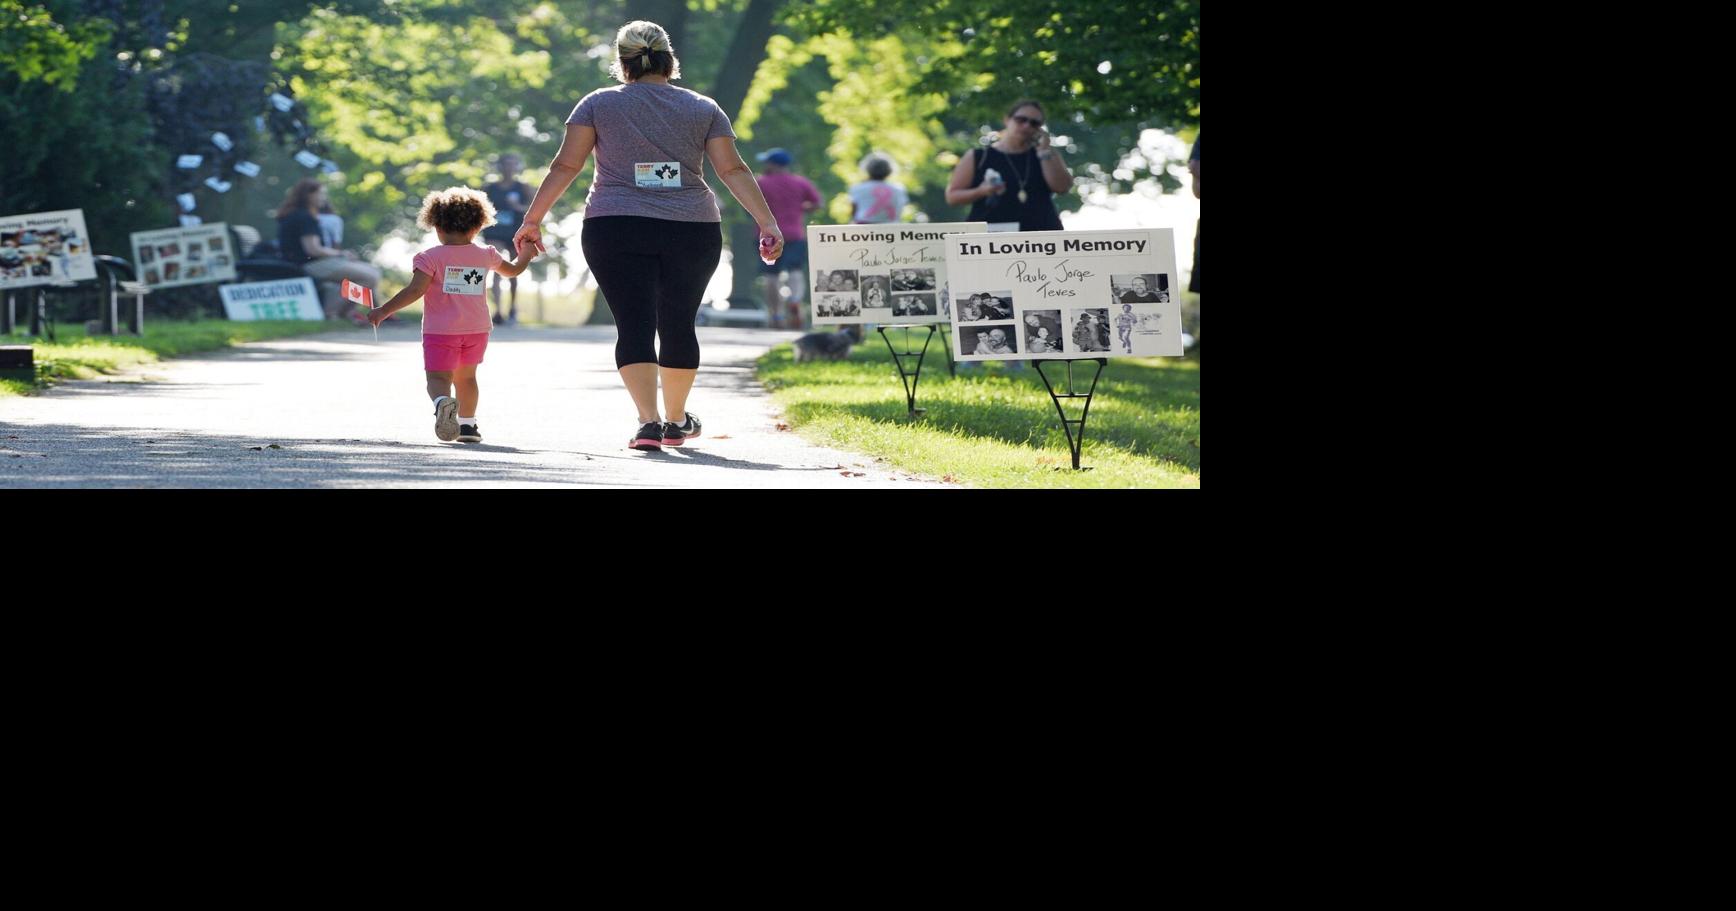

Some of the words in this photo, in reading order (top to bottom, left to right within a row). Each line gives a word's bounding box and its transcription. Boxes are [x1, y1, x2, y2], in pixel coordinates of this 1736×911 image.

[819, 232, 837, 243] In
[842, 231, 895, 244] Loving
[900, 231, 966, 242] Memo
[959, 242, 982, 256] In
[989, 240, 1056, 256] Loving
[1063, 238, 1147, 253] Memory
[1005, 260, 1047, 283] Paulo
[1054, 259, 1095, 283] Jorge
[229, 283, 306, 301] DEDICATION
[1036, 281, 1077, 299] Teves
[250, 299, 300, 320] TREE
